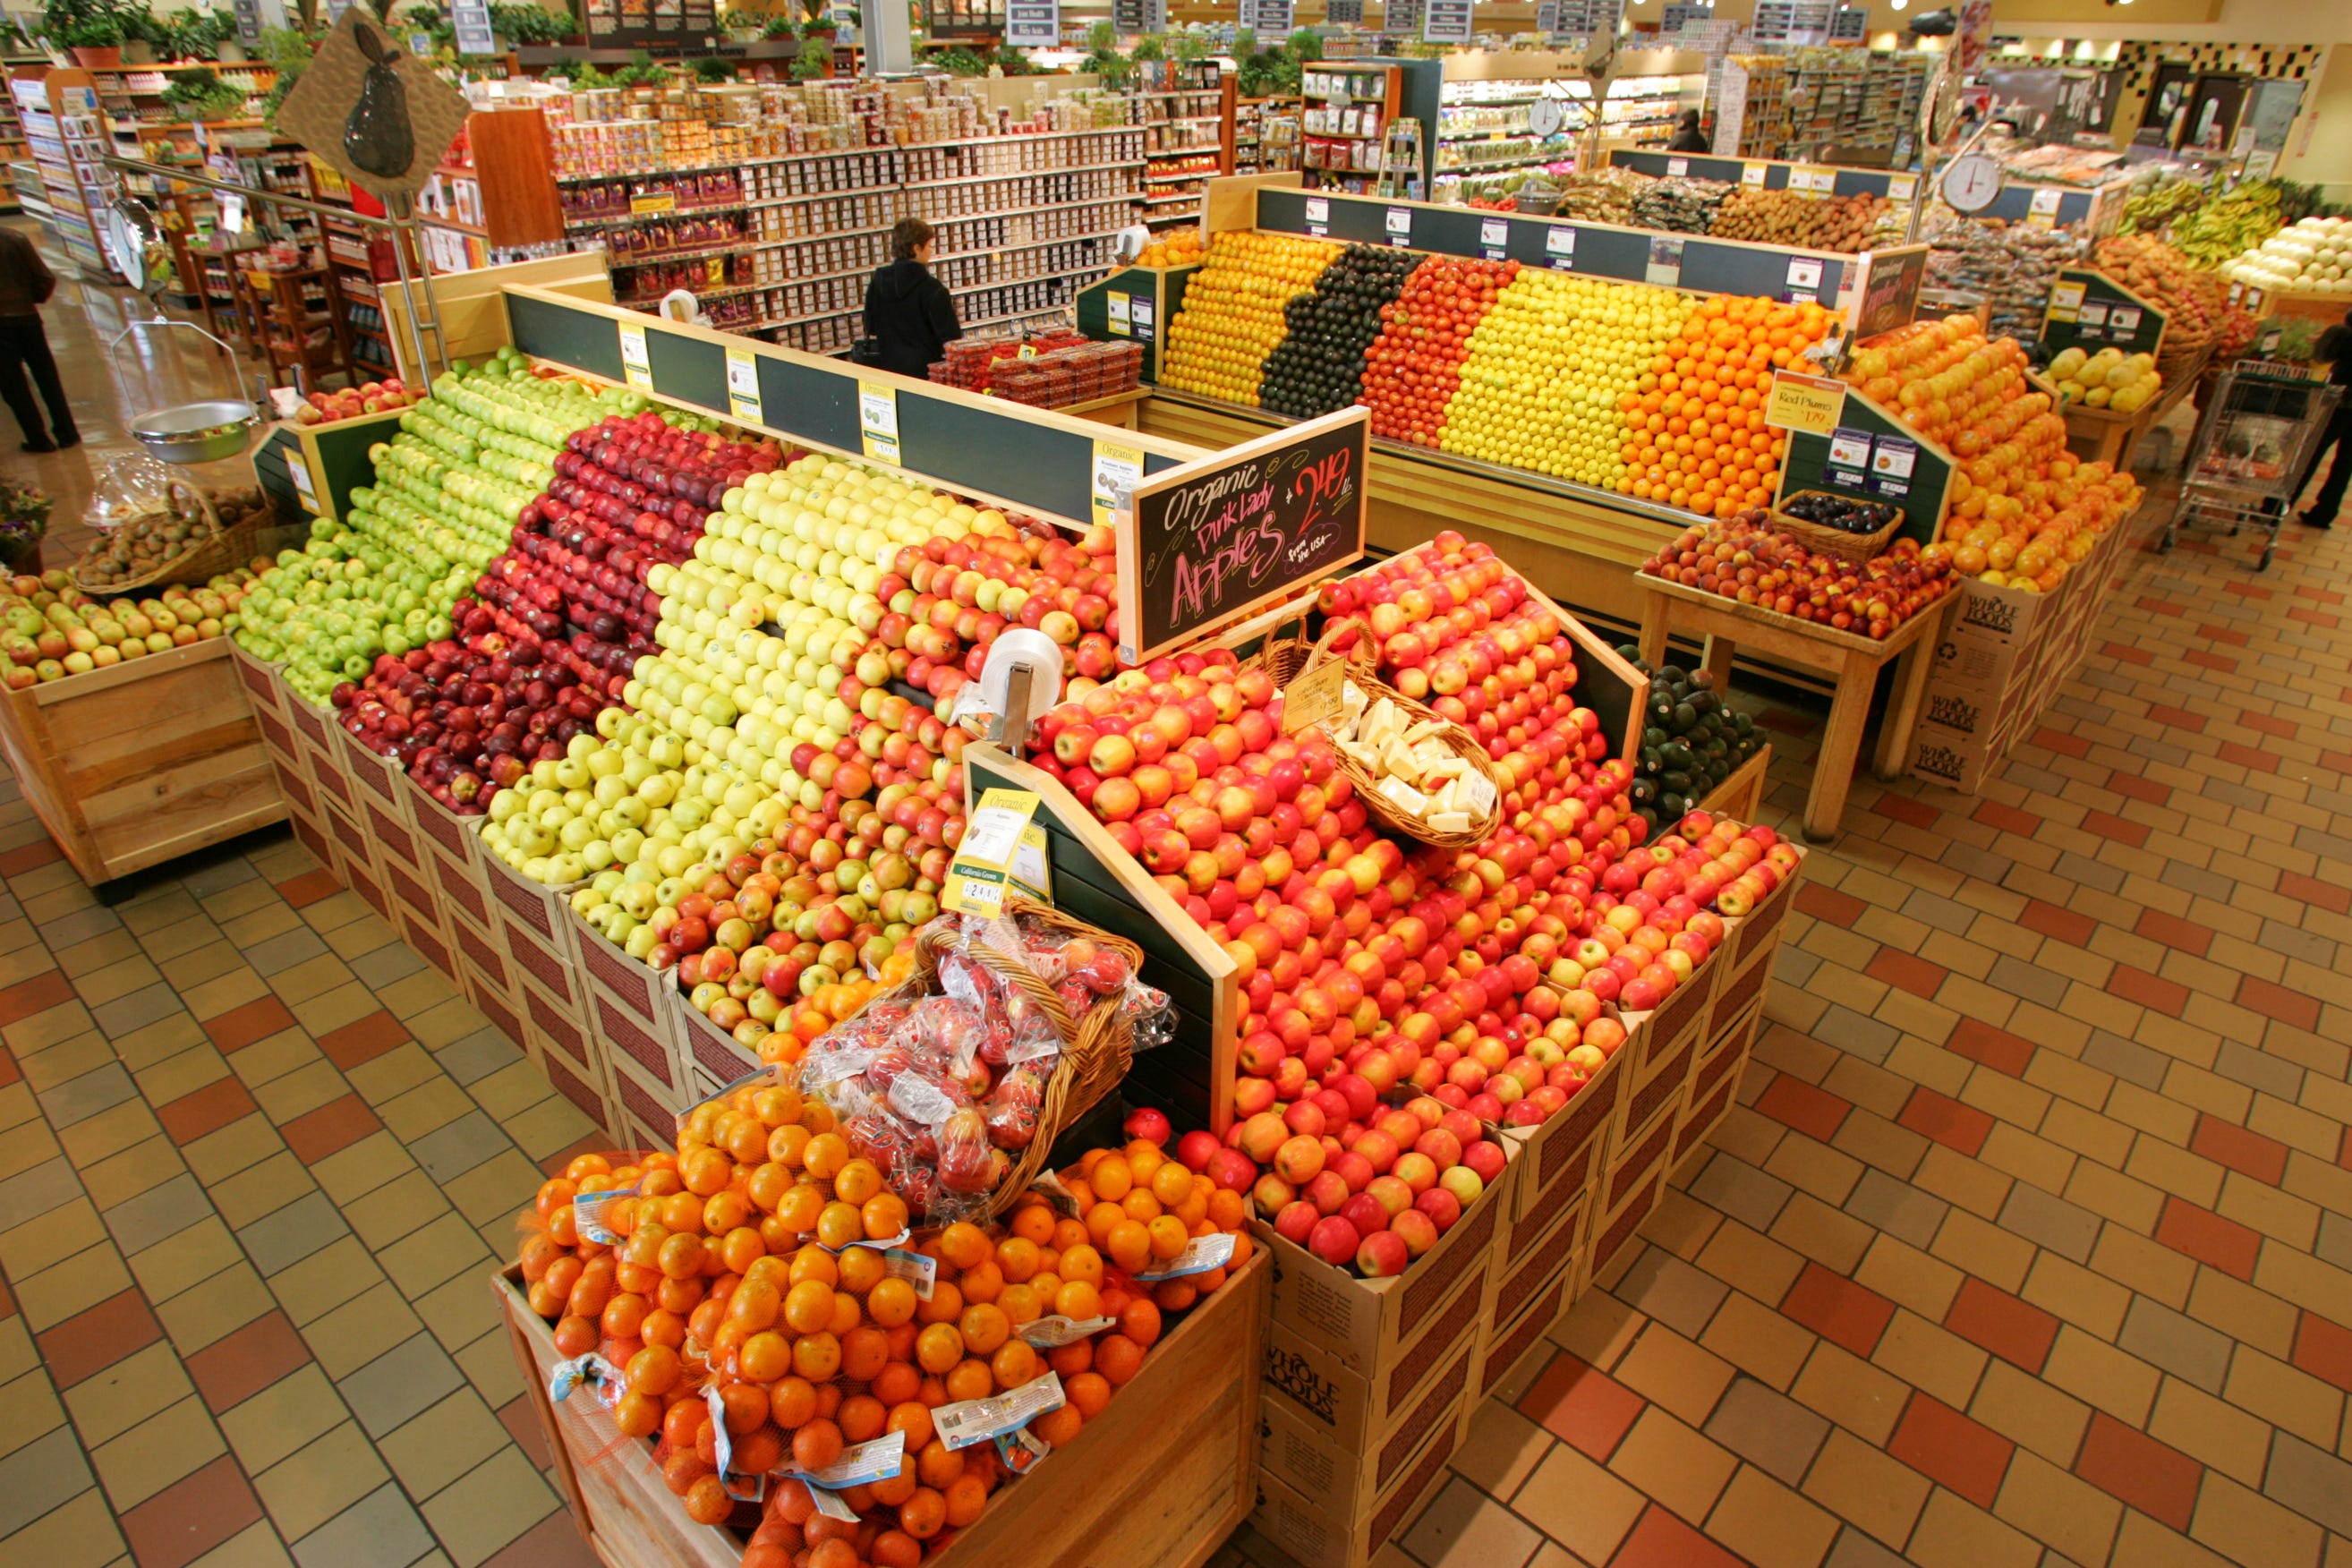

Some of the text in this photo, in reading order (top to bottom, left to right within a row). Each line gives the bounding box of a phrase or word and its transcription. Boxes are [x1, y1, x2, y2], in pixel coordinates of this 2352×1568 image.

[1779, 392, 1800, 405] Red
[1102, 443, 1136, 460] Organic
[1164, 464, 1259, 532] Organic
[1239, 480, 1275, 523] Lady
[1967, 607, 2013, 627] FOODS
[1968, 595, 2020, 618] WHOLE
[1930, 705, 1975, 729] FOODS
[1931, 695, 1981, 717] WHOLE
[1918, 754, 1963, 777] FOODS
[1919, 744, 1969, 766] WHOLE
[989, 794, 1027, 811] Organic
[1270, 1364, 1334, 1416] OODS
